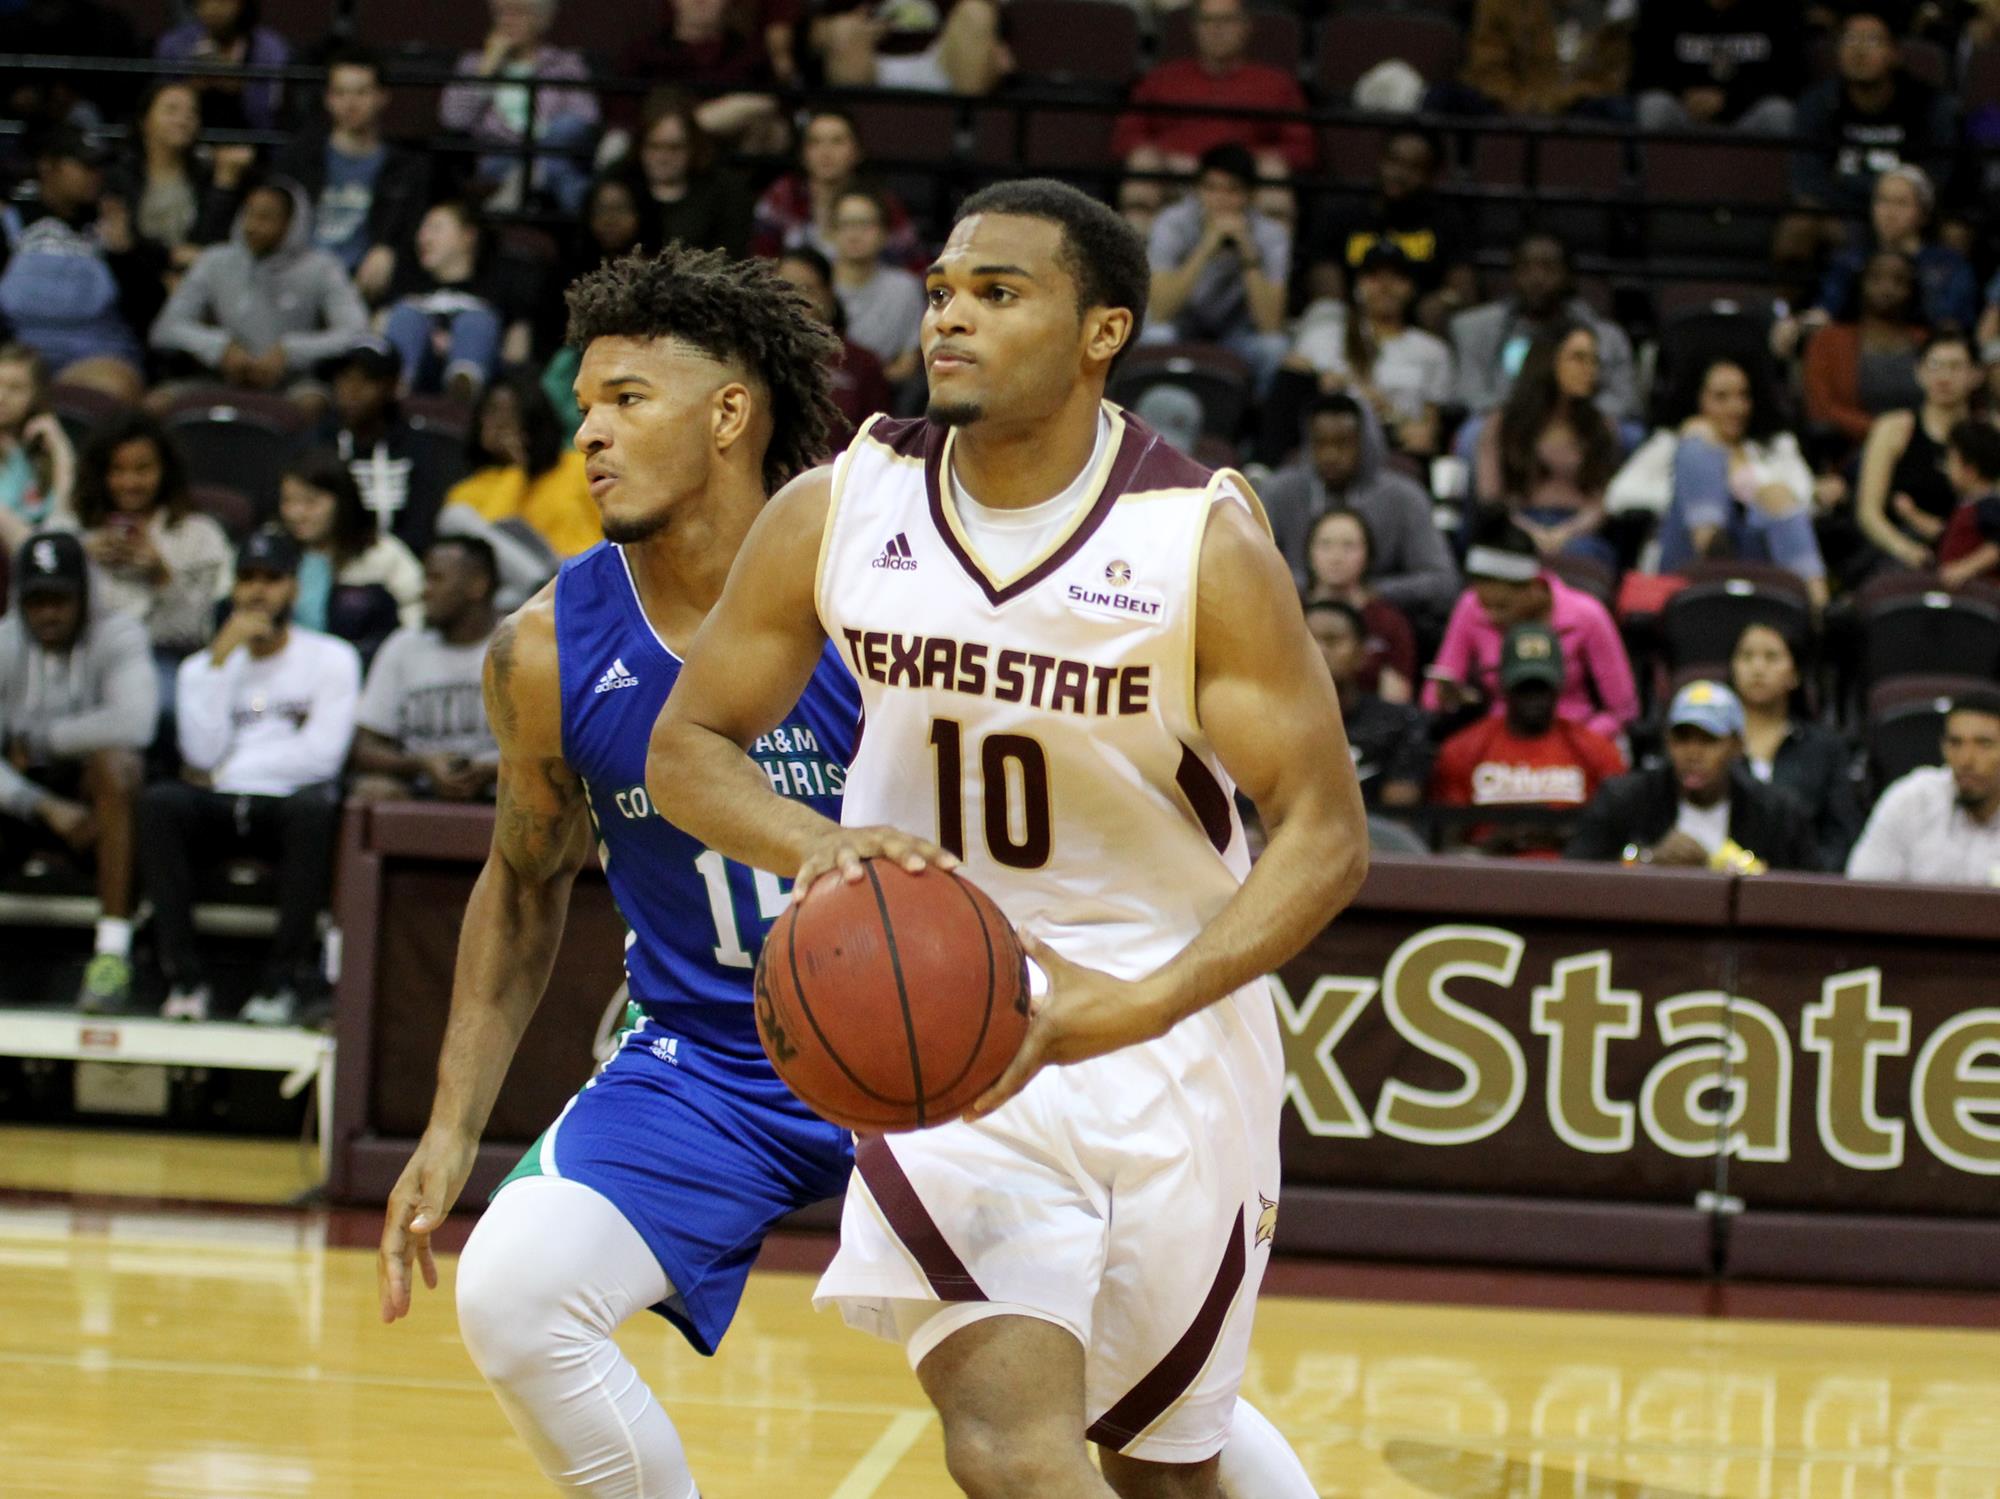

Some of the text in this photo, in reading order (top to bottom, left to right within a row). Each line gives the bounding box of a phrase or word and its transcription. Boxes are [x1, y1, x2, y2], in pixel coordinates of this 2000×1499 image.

[871, 552, 918, 571] adidas
[594, 676, 639, 694] adidas
[842, 627, 1150, 716] TEXAS STATE
[755, 727, 820, 753] A&M
[615, 760, 848, 819] CO HRIS
[930, 718, 1052, 870] 10
